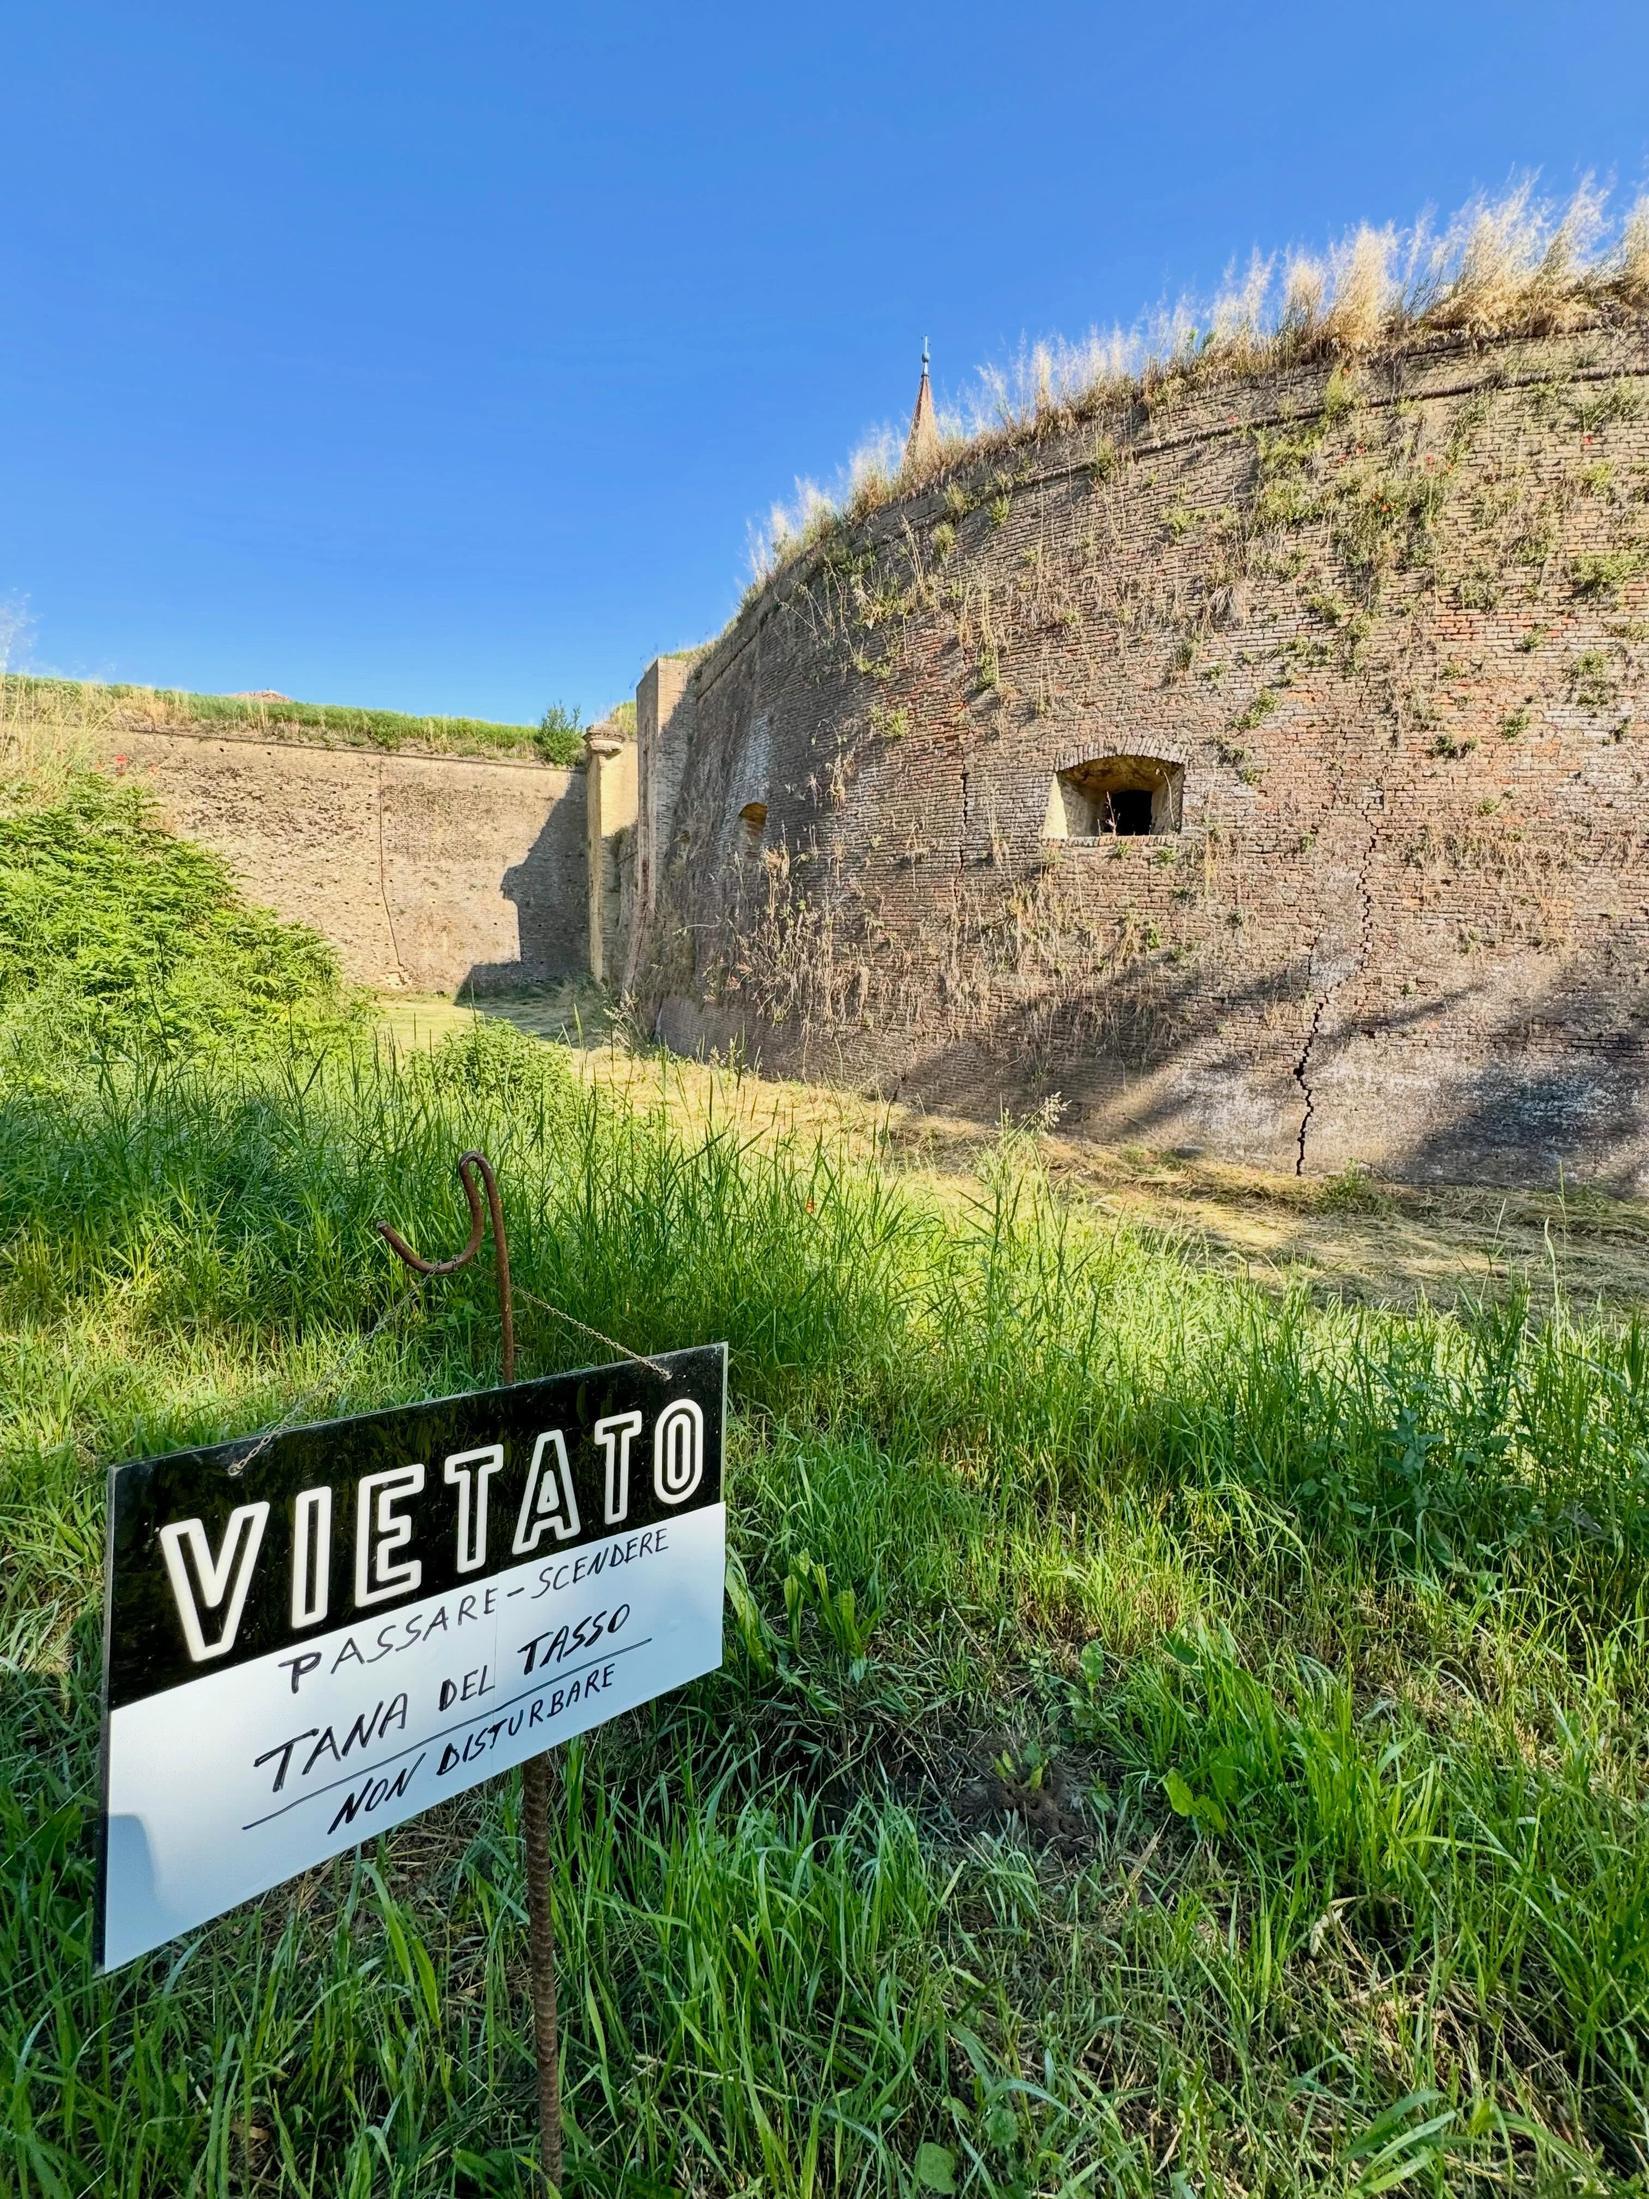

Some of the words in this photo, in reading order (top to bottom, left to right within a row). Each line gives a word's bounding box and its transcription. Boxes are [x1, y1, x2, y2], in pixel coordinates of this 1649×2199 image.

[159, 1398, 704, 1663] VIETATO
[253, 1692, 408, 1793] TANA
[438, 1665, 495, 1713] DEL
[518, 1603, 631, 1675] TASSO
[328, 1751, 426, 1835] NON
[436, 1663, 616, 1777] DISTURBARE
